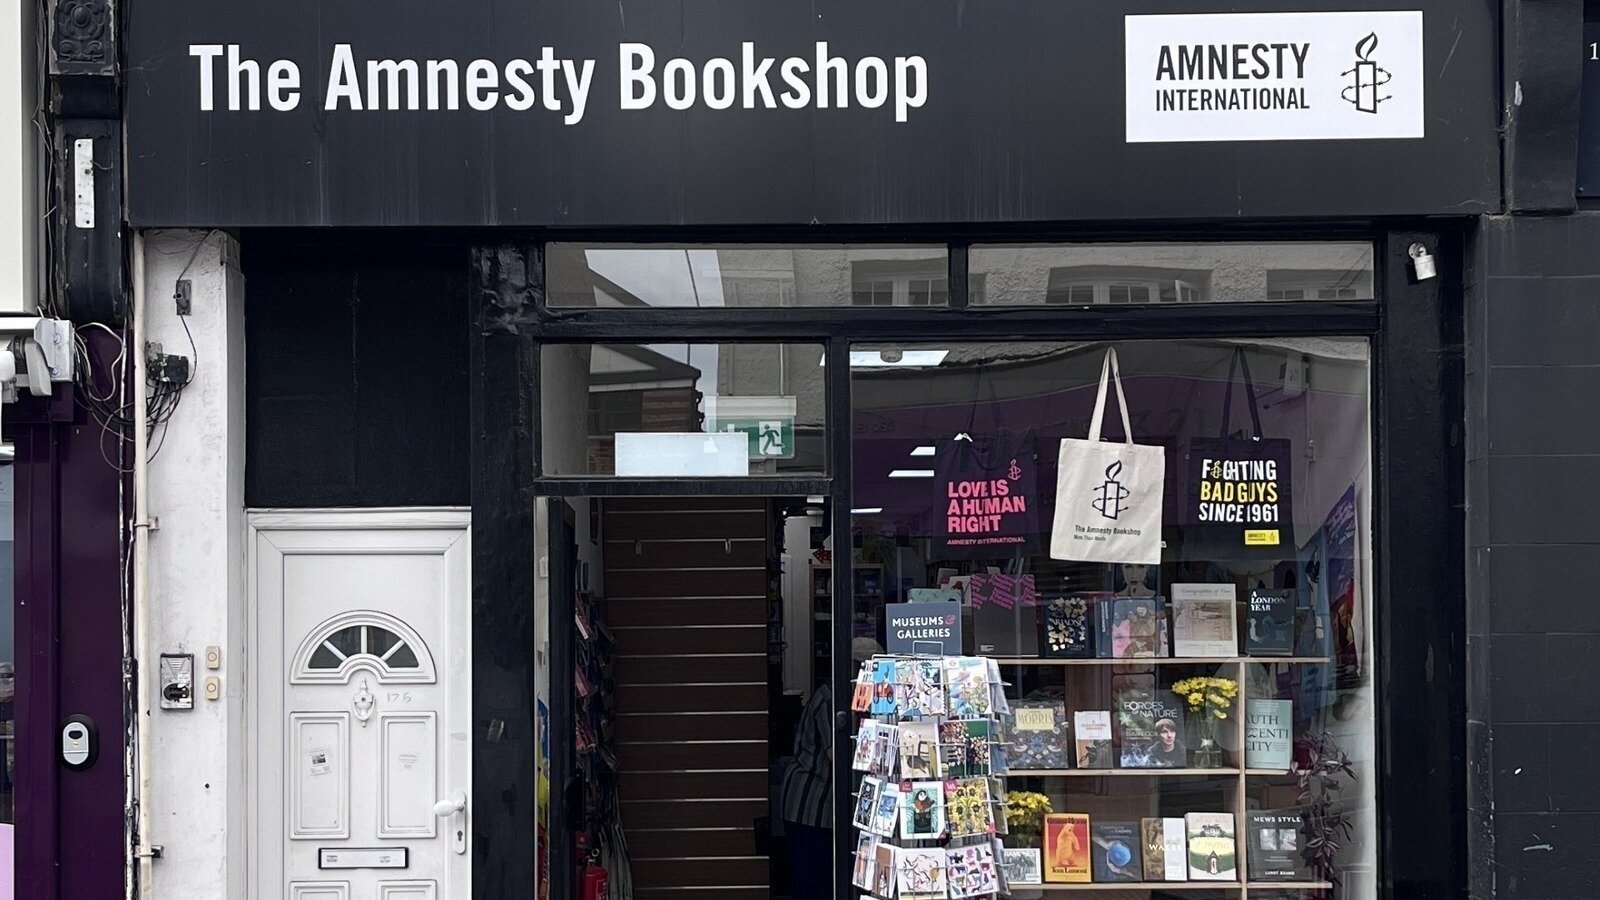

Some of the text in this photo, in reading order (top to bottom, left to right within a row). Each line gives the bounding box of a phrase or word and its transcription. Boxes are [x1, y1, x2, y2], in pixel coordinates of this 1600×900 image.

[1156, 43, 1310, 81] AMNESTY
[189, 41, 928, 126] The Amnesty Bookshop
[1156, 87, 1310, 111] INTERNATIONAL
[948, 479, 1009, 498] LOVE IS
[1200, 480, 1278, 503] BAD GUYS
[947, 495, 1026, 515] A HUMAN
[1198, 502, 1279, 522] SINCE 1961
[947, 515, 1002, 533] RIGHT
[1087, 526, 1112, 535] Amnesty
[1113, 527, 1141, 536] Bookshop
[977, 536, 1026, 545] INTERNATIONAL
[892, 616, 944, 627] MUSEUMS
[896, 628, 951, 639] GALLERIES
[1123, 701, 1164, 711] FORCES
[1139, 708, 1178, 718] NATURE
